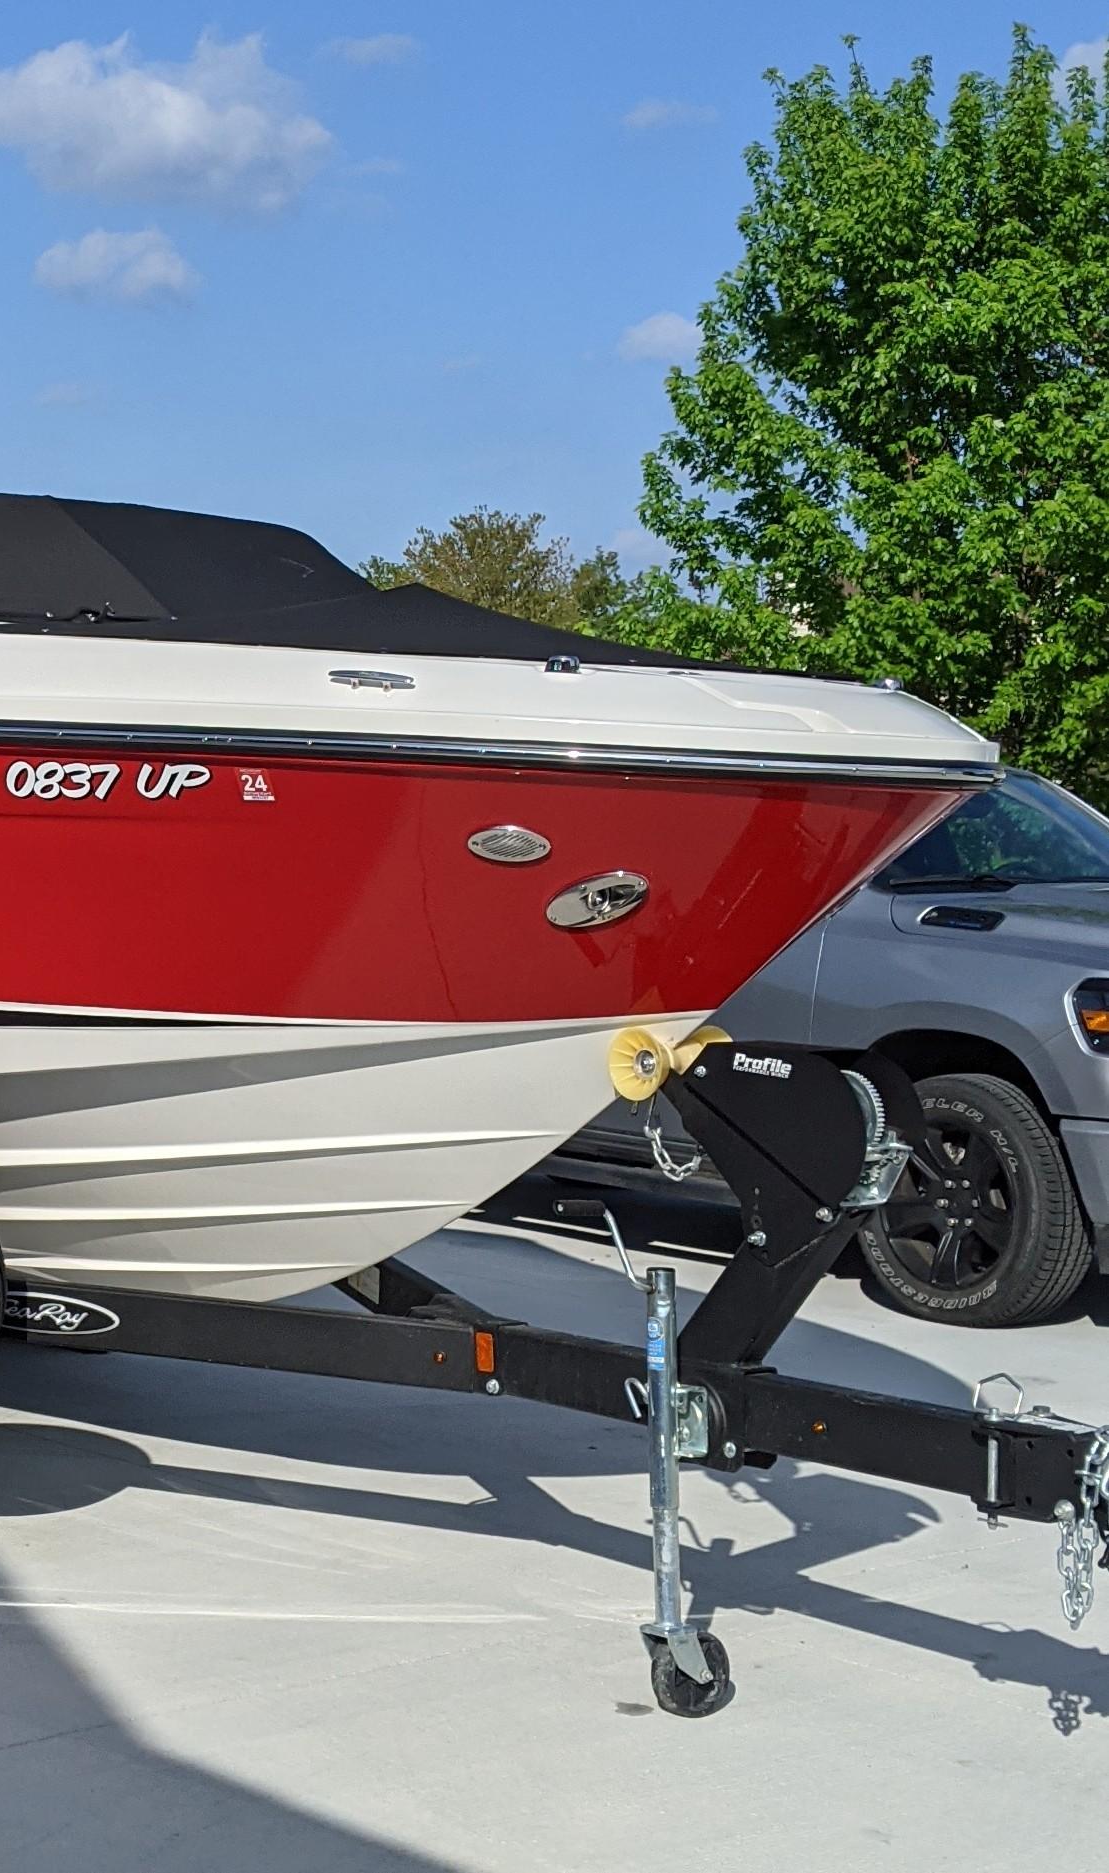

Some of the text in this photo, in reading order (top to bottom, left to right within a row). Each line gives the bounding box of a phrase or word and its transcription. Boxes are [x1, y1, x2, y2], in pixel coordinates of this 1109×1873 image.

[5, 760, 122, 801] 0837
[136, 762, 212, 800] UP
[241, 774, 268, 792] 24
[733, 1052, 792, 1075] Profile
[922, 1097, 985, 1124] ELER
